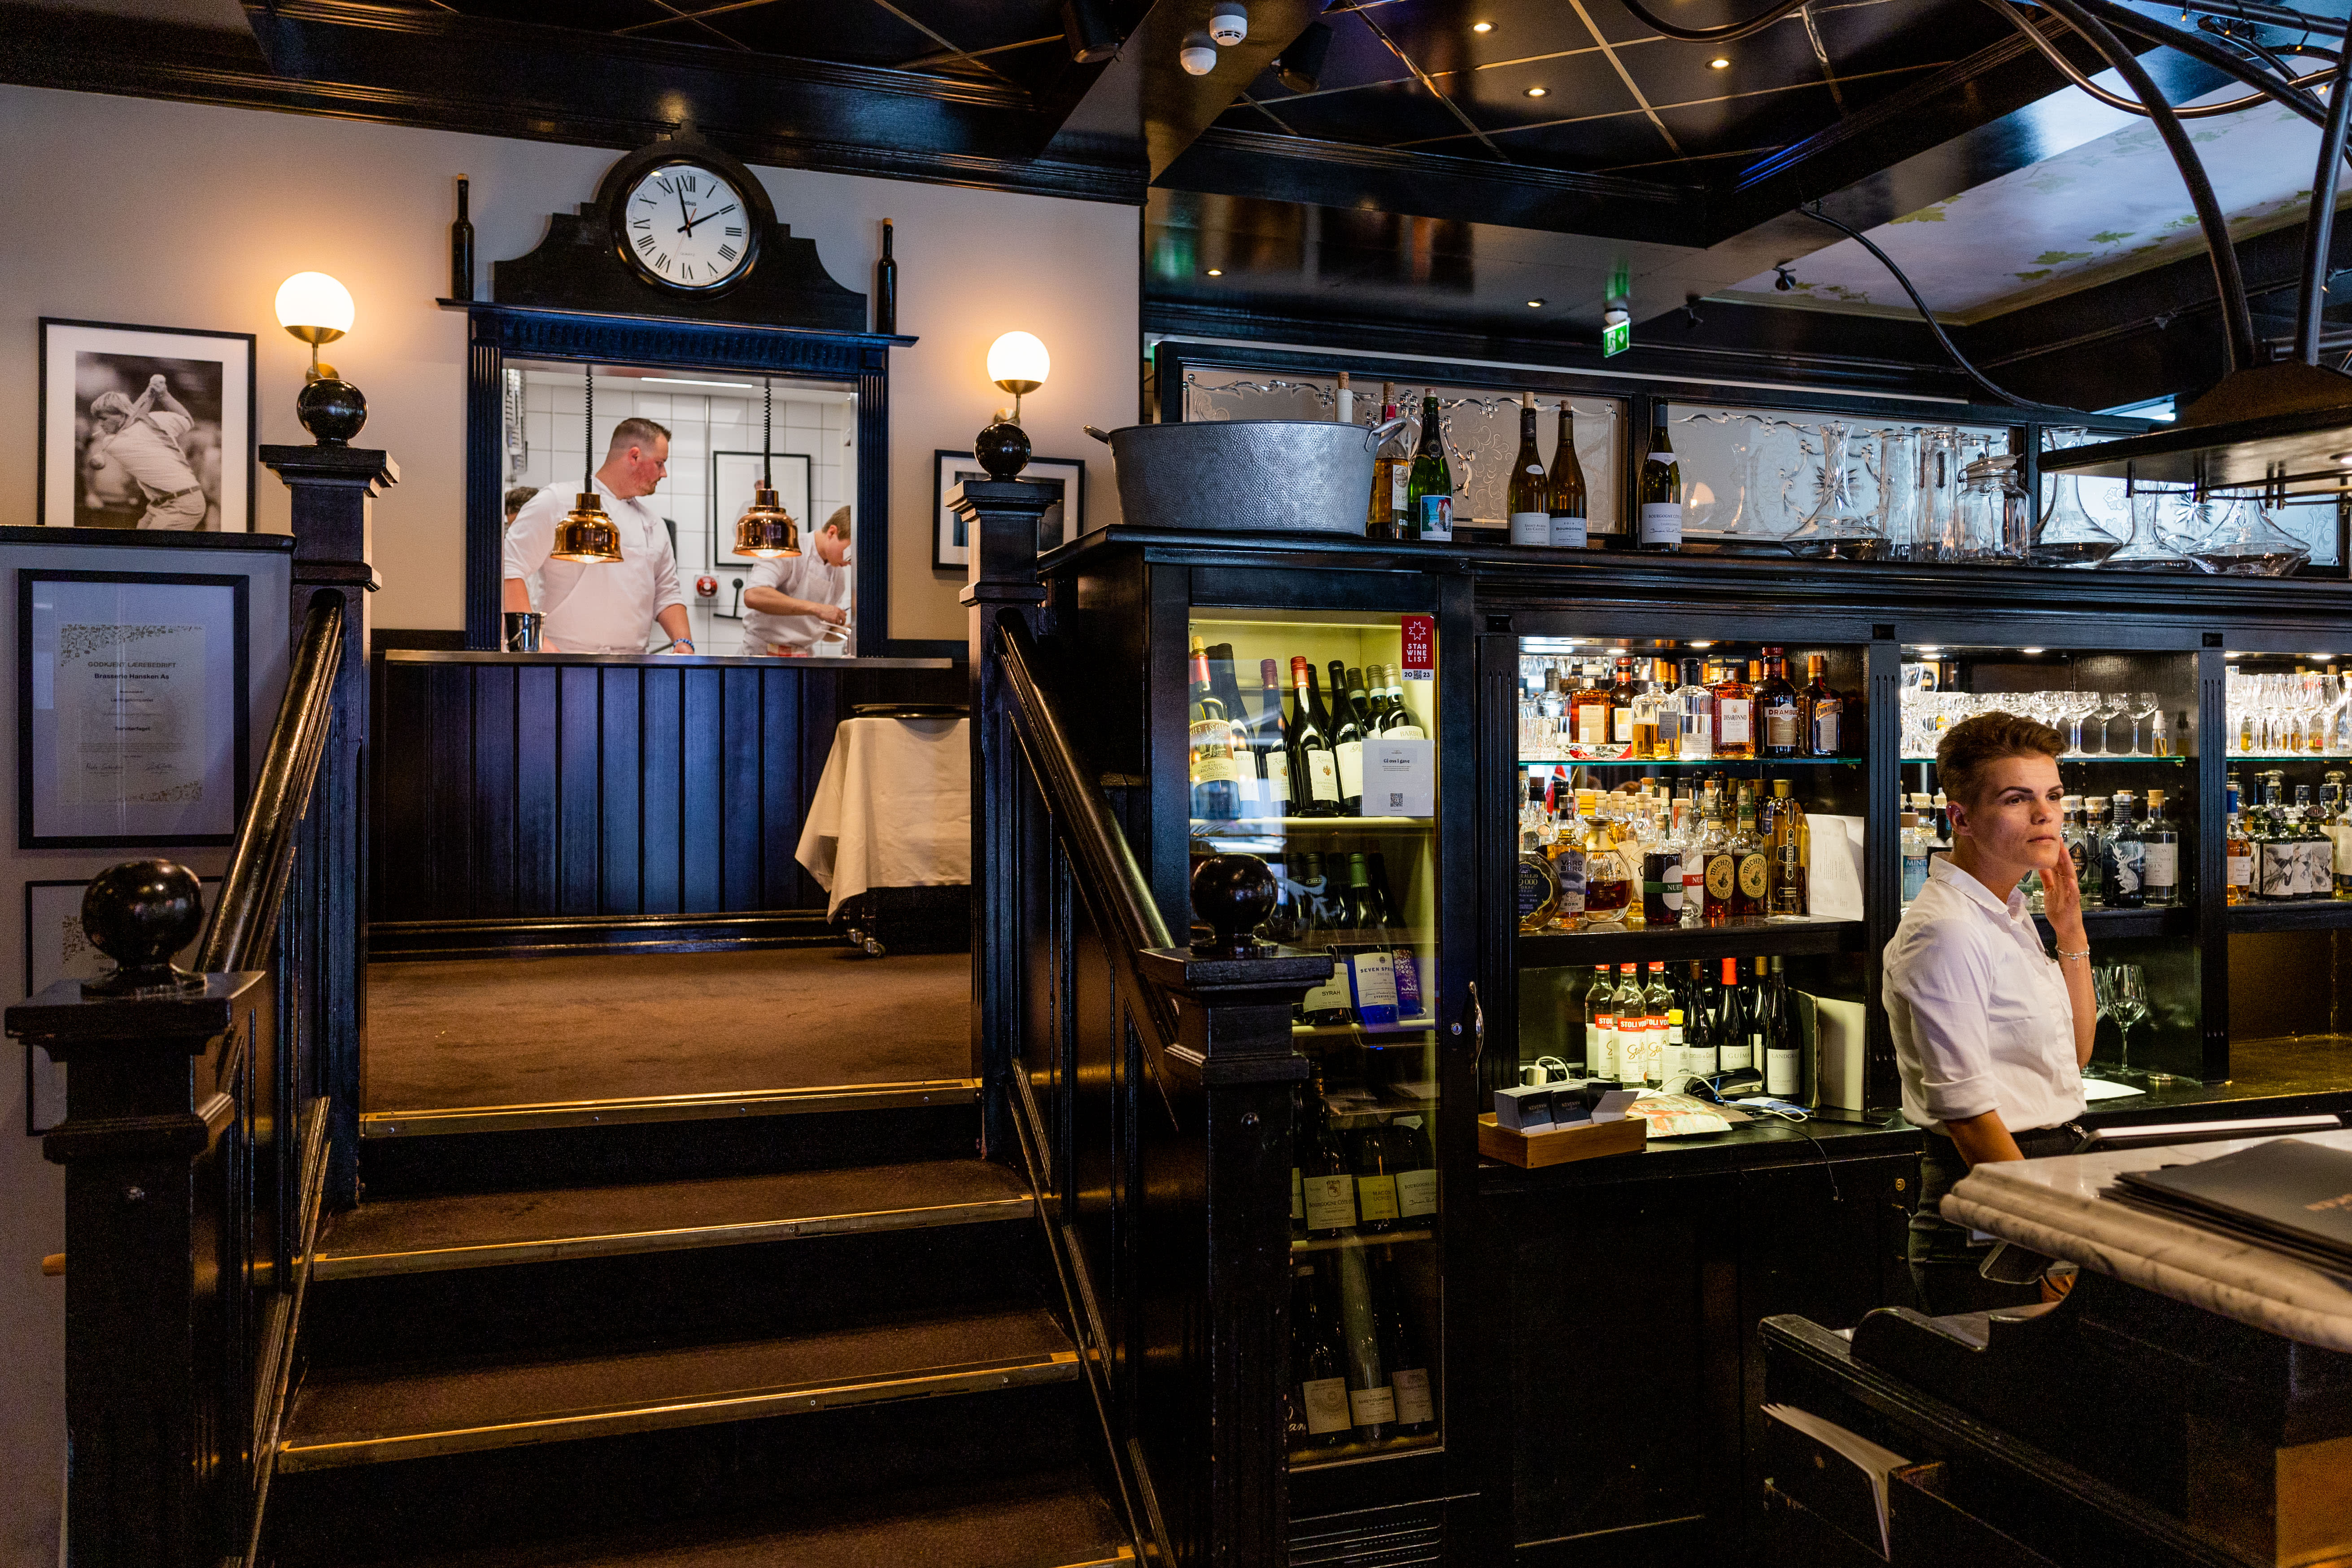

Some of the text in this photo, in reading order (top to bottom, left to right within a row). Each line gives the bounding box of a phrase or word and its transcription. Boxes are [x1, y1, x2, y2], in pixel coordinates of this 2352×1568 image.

[656, 178, 674, 197] XI
[680, 175, 696, 192] XII
[639, 194, 657, 209] X
[719, 203, 736, 215] II
[633, 217, 650, 229] IX
[725, 227, 742, 237] III
[637, 234, 657, 256] VIII
[717, 244, 737, 262] IIII
[655, 253, 672, 273] VII
[682, 262, 694, 280] VI
[707, 261, 718, 276] V
[1197, 765, 1229, 774] GRIGNOLINO
[1627, 1042, 1645, 1059] Stoli
